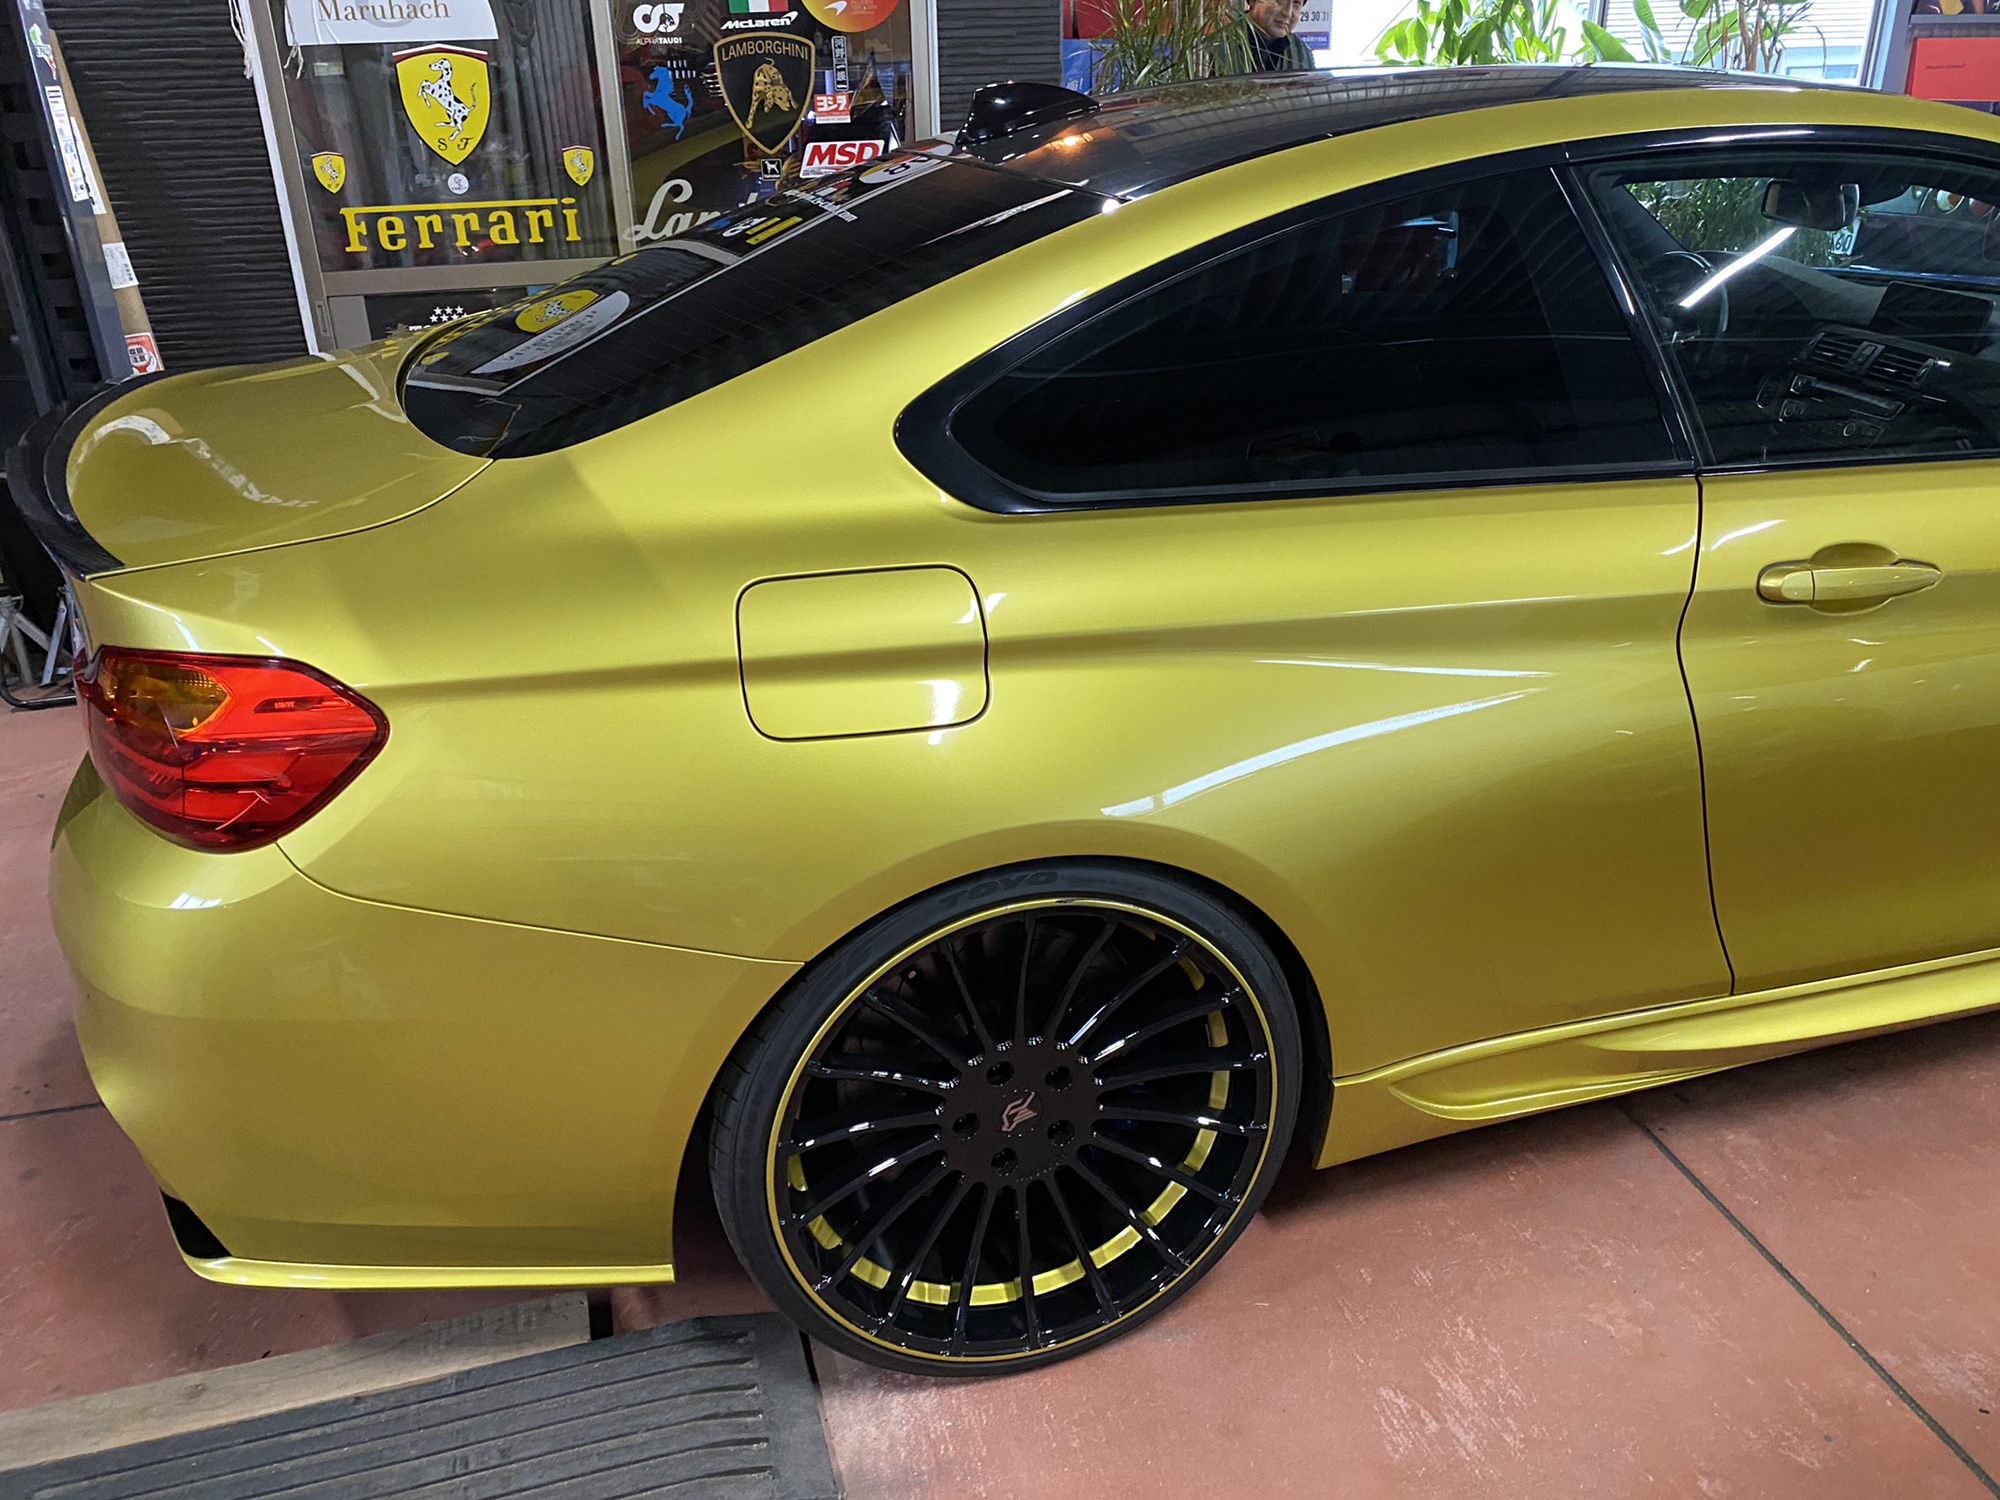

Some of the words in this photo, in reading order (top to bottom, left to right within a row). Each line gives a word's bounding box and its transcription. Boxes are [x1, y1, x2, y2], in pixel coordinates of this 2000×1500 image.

[720, 17, 793, 30] McLaren
[1311, 11, 1320, 21] 30
[1322, 11, 1329, 21] 31
[636, 36, 683, 46] ALPHATAURI
[721, 41, 809, 61] LAMBORGHINI
[807, 142, 880, 166] MSD
[339, 197, 581, 252] Ferrari
[939, 871, 1058, 908] TOYO
